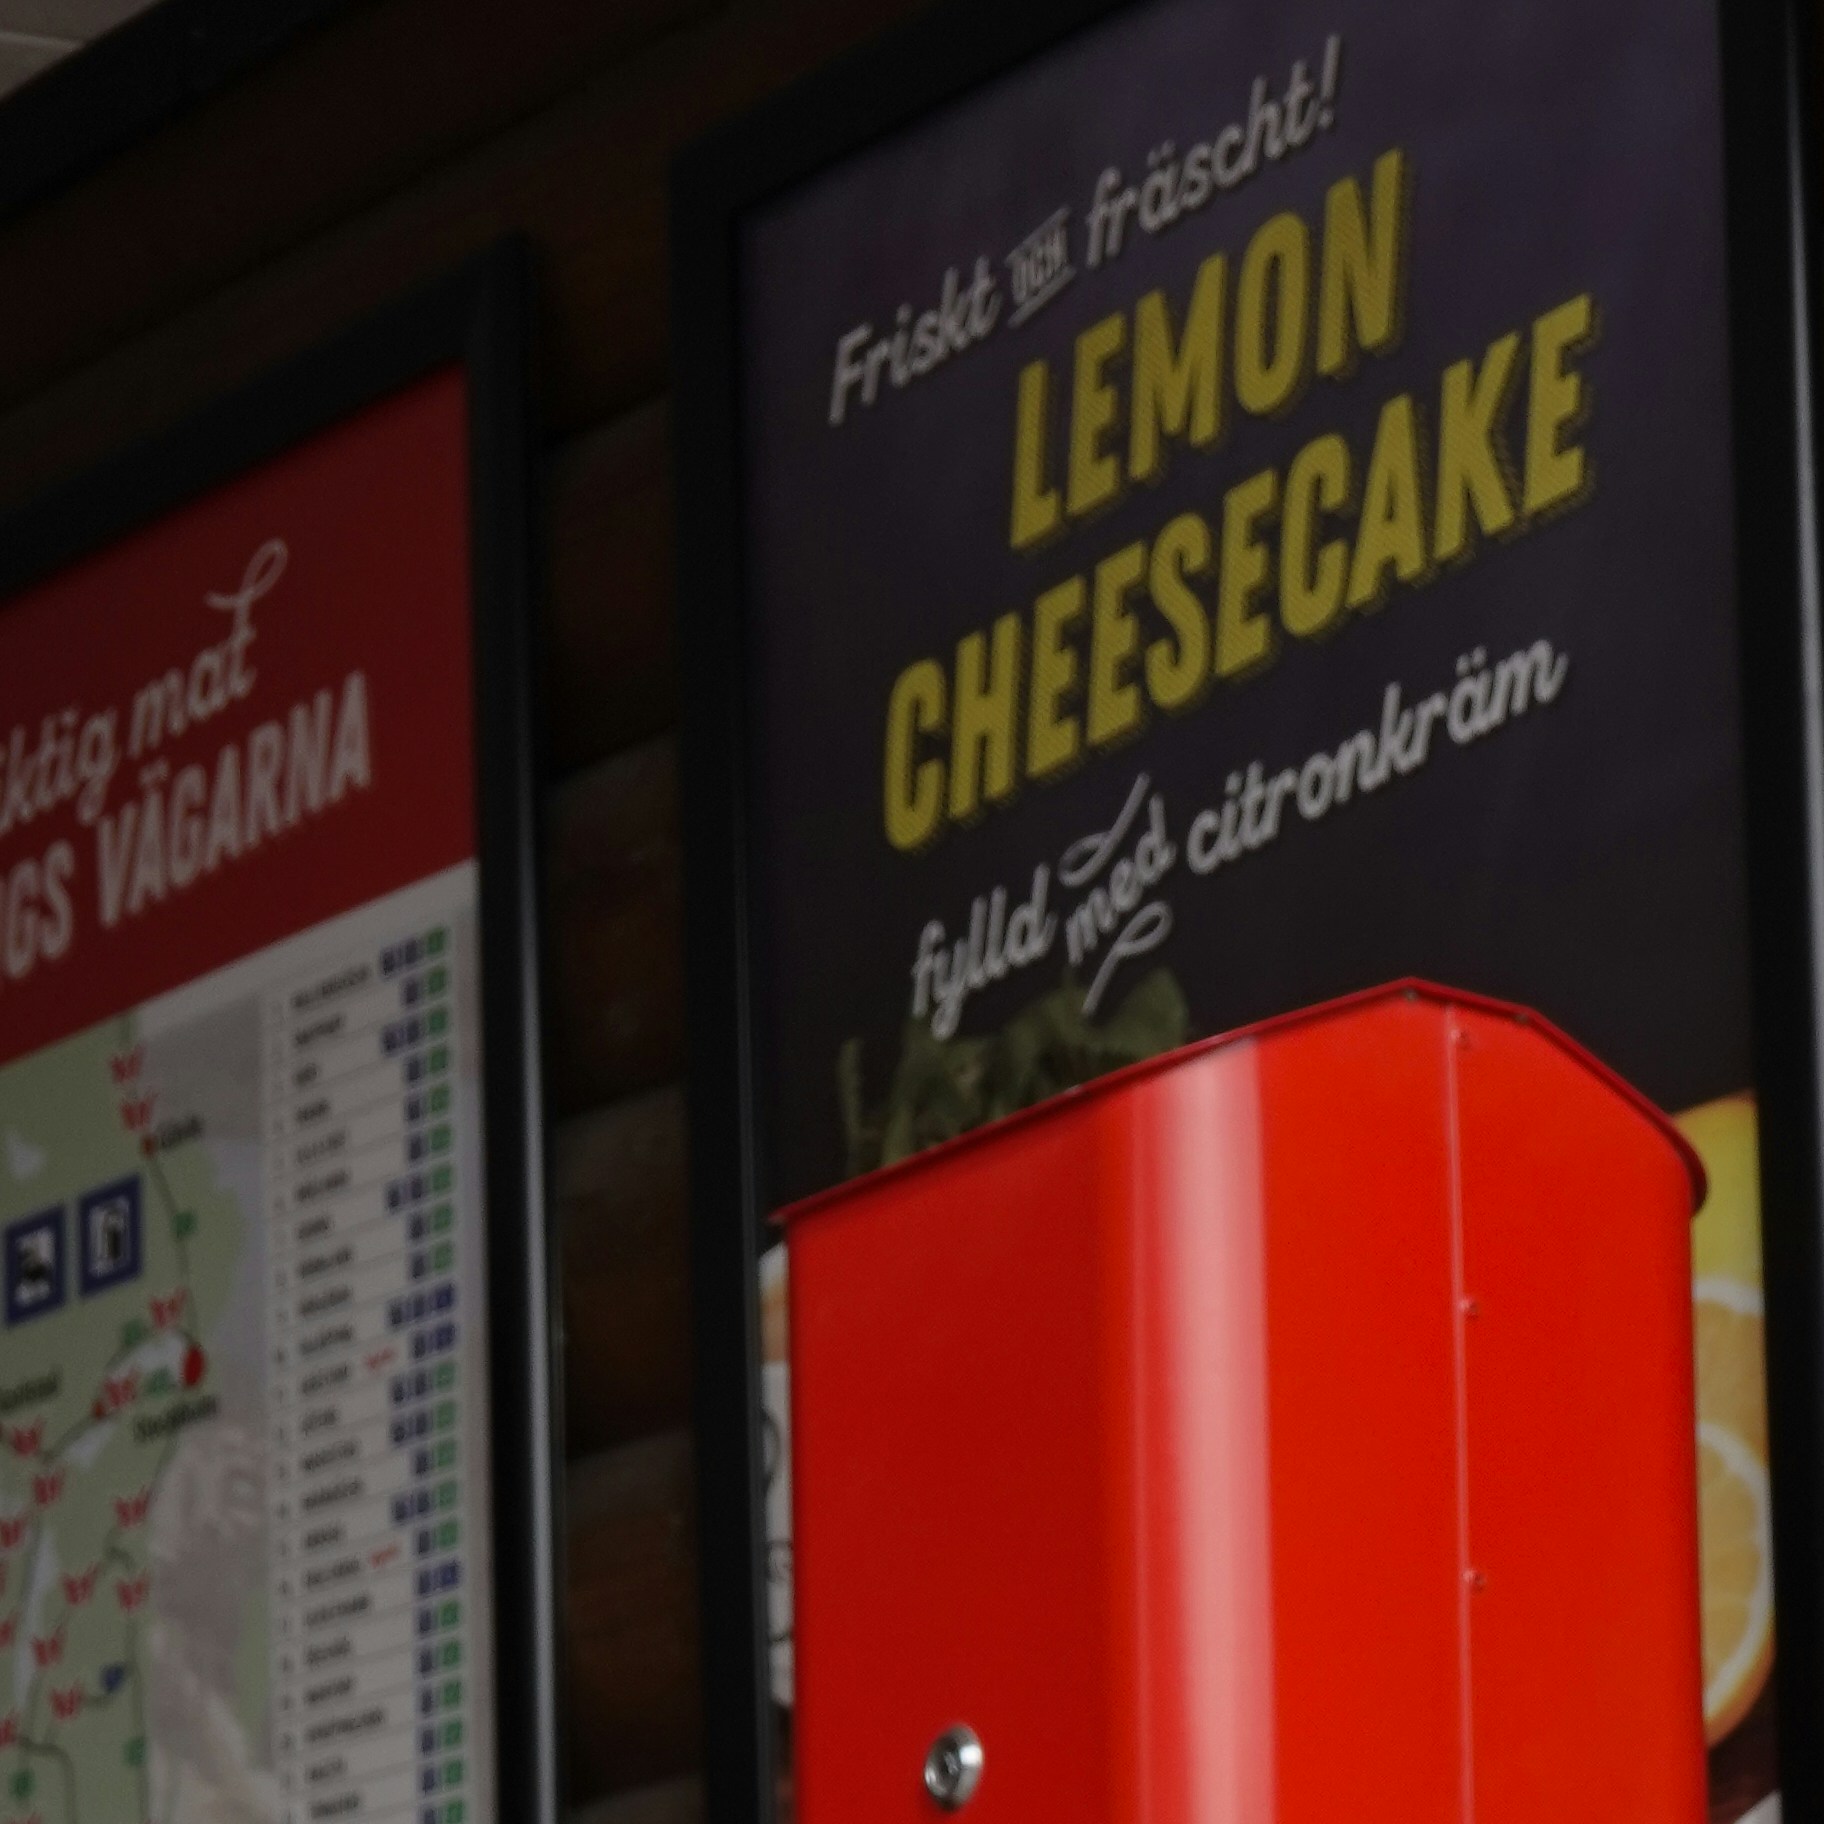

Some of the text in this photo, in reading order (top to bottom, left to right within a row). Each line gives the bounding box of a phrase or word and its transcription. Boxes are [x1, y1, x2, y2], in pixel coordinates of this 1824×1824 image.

[828, 254, 1001, 426] Friskt
[1085, 33, 1342, 271] fräscht!
[1009, 146, 1410, 553] LEMON
[0, 537, 288, 836] ktig mat
[883, 292, 1595, 855] CHEESECAKE
[0, 669, 371, 981] GS VÄGARNA
[912, 637, 1570, 1042] fylld med citronkräm
